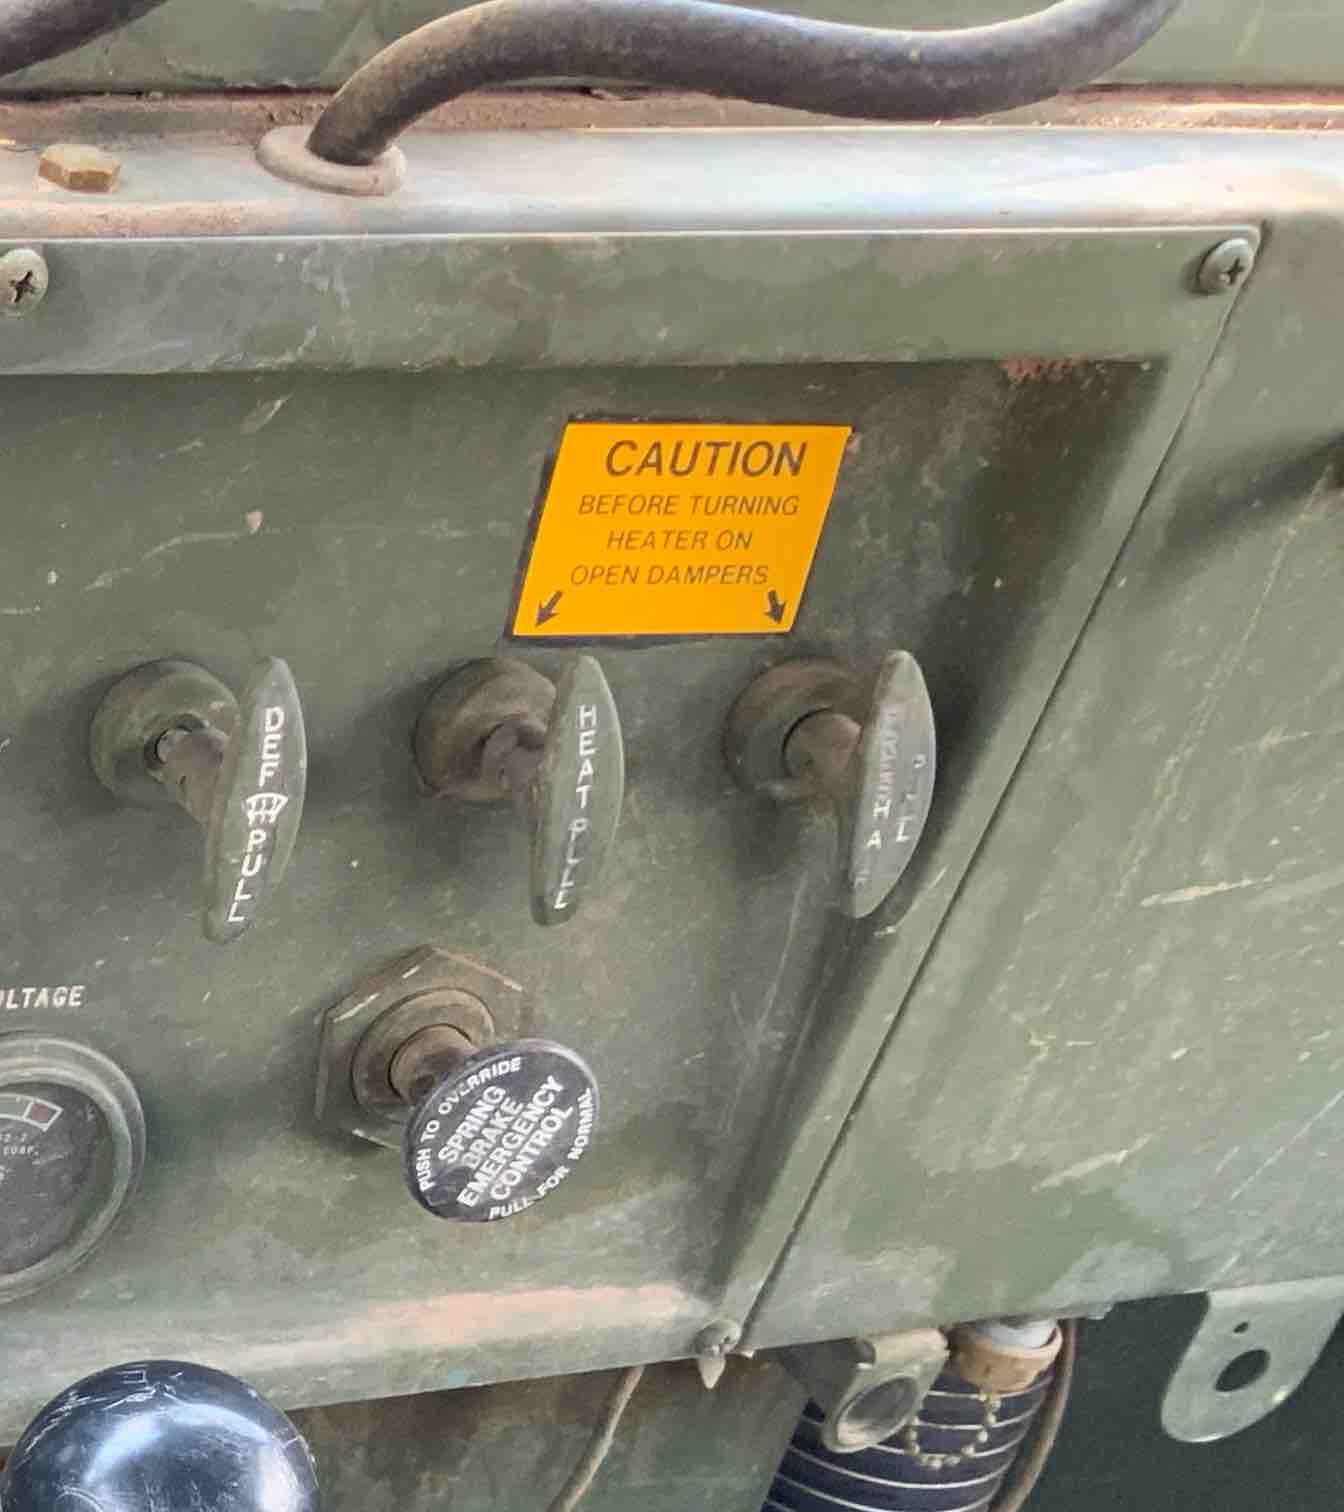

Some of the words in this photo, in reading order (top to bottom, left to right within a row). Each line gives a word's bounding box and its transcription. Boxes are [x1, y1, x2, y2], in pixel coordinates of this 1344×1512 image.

[604, 440, 808, 477] CAUTION
[578, 494, 681, 516] BEFORE
[690, 494, 800, 517] TURNING
[607, 530, 708, 551] HEATER
[716, 530, 753, 551] ON
[570, 565, 640, 586] OPEN
[647, 565, 769, 586] DAMPERS
[259, 706, 285, 787] DEF
[576, 704, 598, 809] HEAT
[228, 828, 267, 923] PULL
[439, 1056, 522, 1115] OVERRIDE
[421, 1119, 440, 1143] TO
[438, 1085, 507, 1164] SPRING
[457, 1075, 564, 1208] EMERGENCY
[461, 1097, 525, 1170] BRAKE
[490, 1106, 574, 1201] CONTROL
[415, 1148, 436, 1192] PUSH
[489, 1197, 534, 1220] PULL
[536, 1165, 570, 1197] FOR
